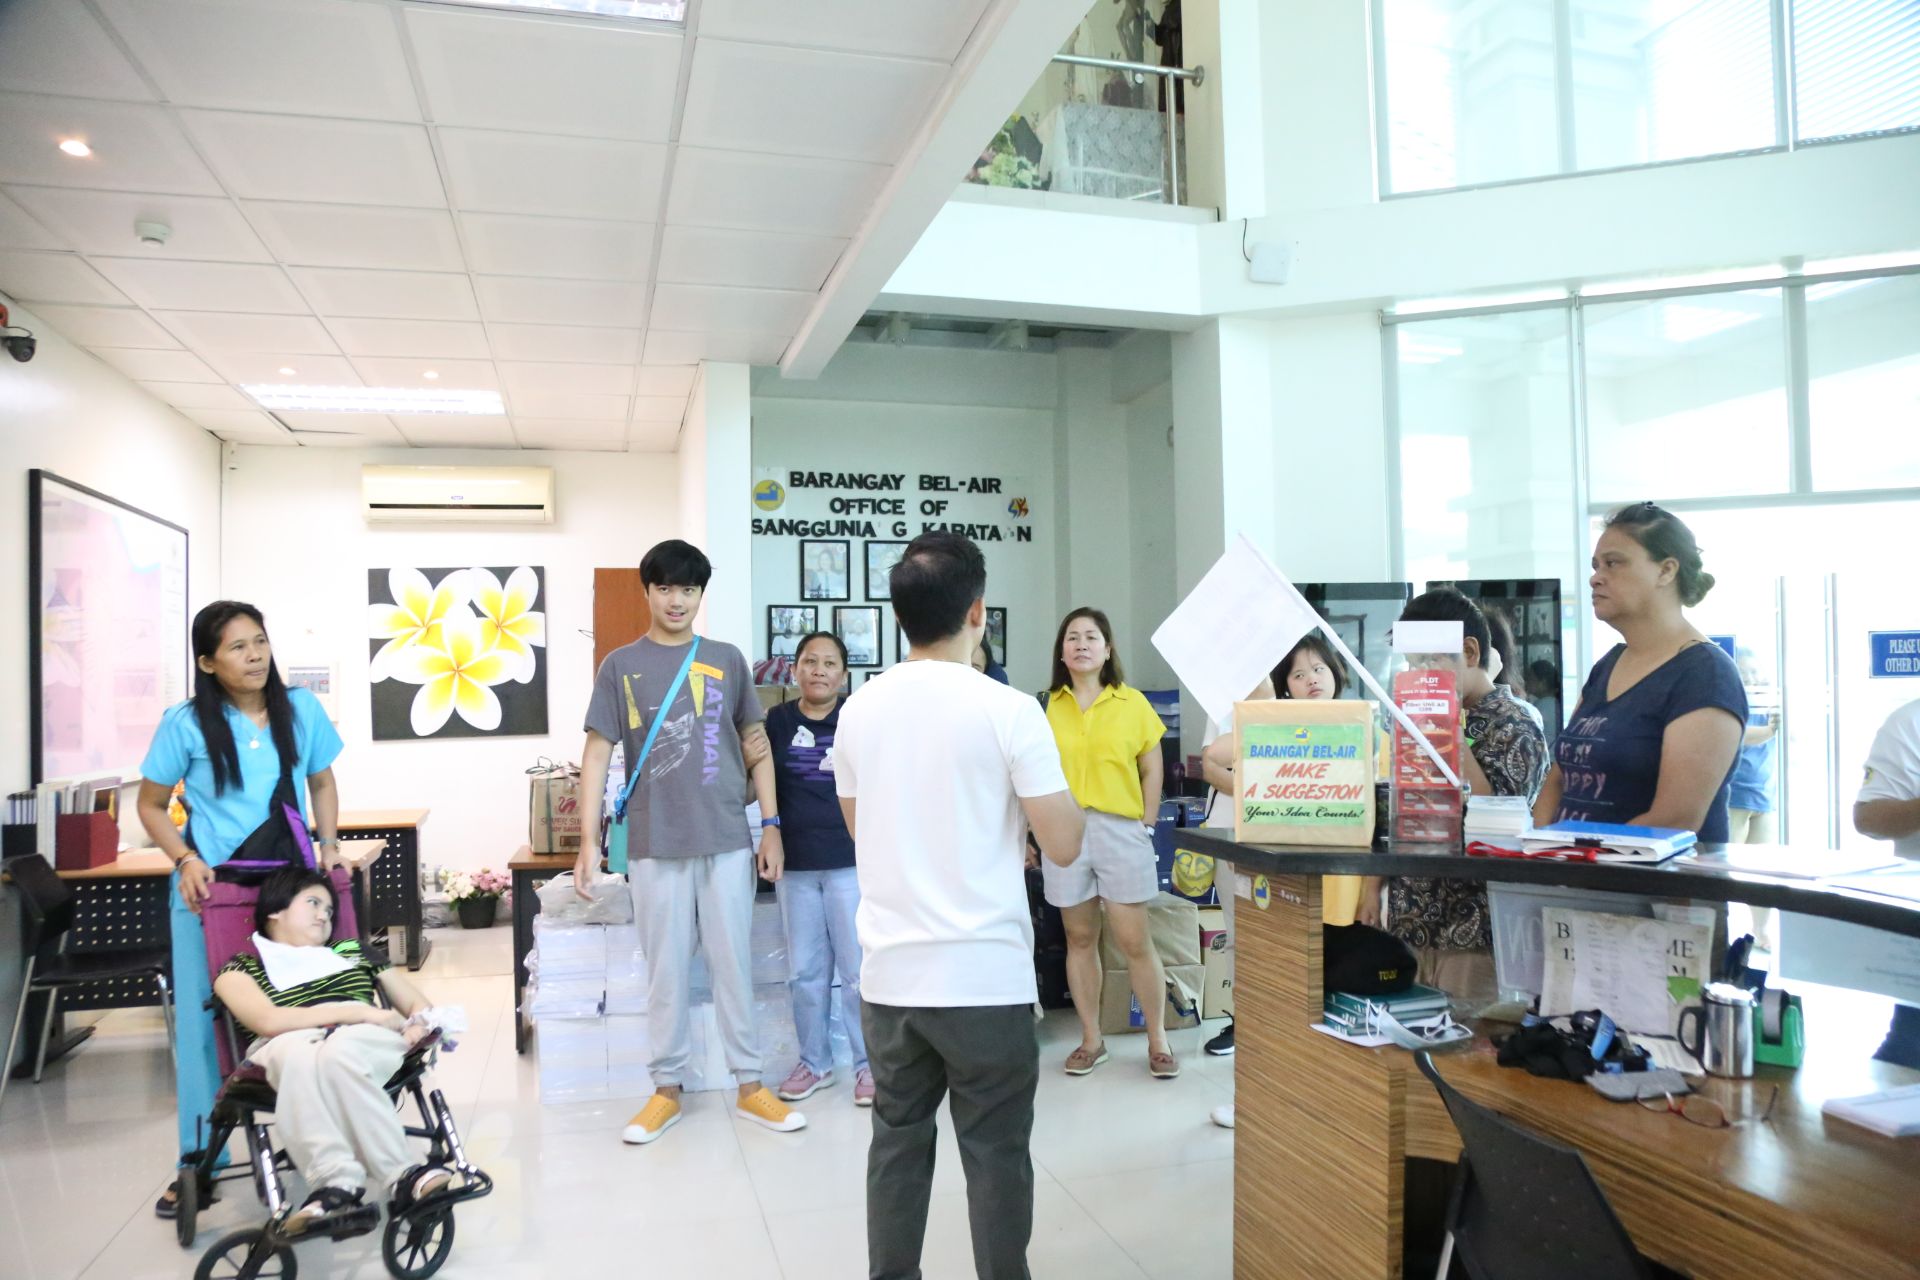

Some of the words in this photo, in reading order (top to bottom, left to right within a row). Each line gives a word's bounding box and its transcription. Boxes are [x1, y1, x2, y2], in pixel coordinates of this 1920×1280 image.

[789, 471, 906, 491] BARANGAY
[918, 474, 1002, 494] BEL-AIR
[829, 496, 906, 516] OFFICE
[919, 499, 949, 516] OF
[1889, 639, 1916, 654] PLEASE
[1885, 657, 1912, 673] OTHER
[1250, 744, 1310, 758] BARANGAY
[1312, 745, 1357, 759] BEL-AIR
[1275, 762, 1331, 779] MAKE
[1244, 783, 1258, 798] A
[1263, 783, 1364, 800] SUGGESTION
[1243, 805, 1279, 823] Your
[1280, 806, 1311, 818] Idea
[1315, 807, 1365, 818] Counts!
